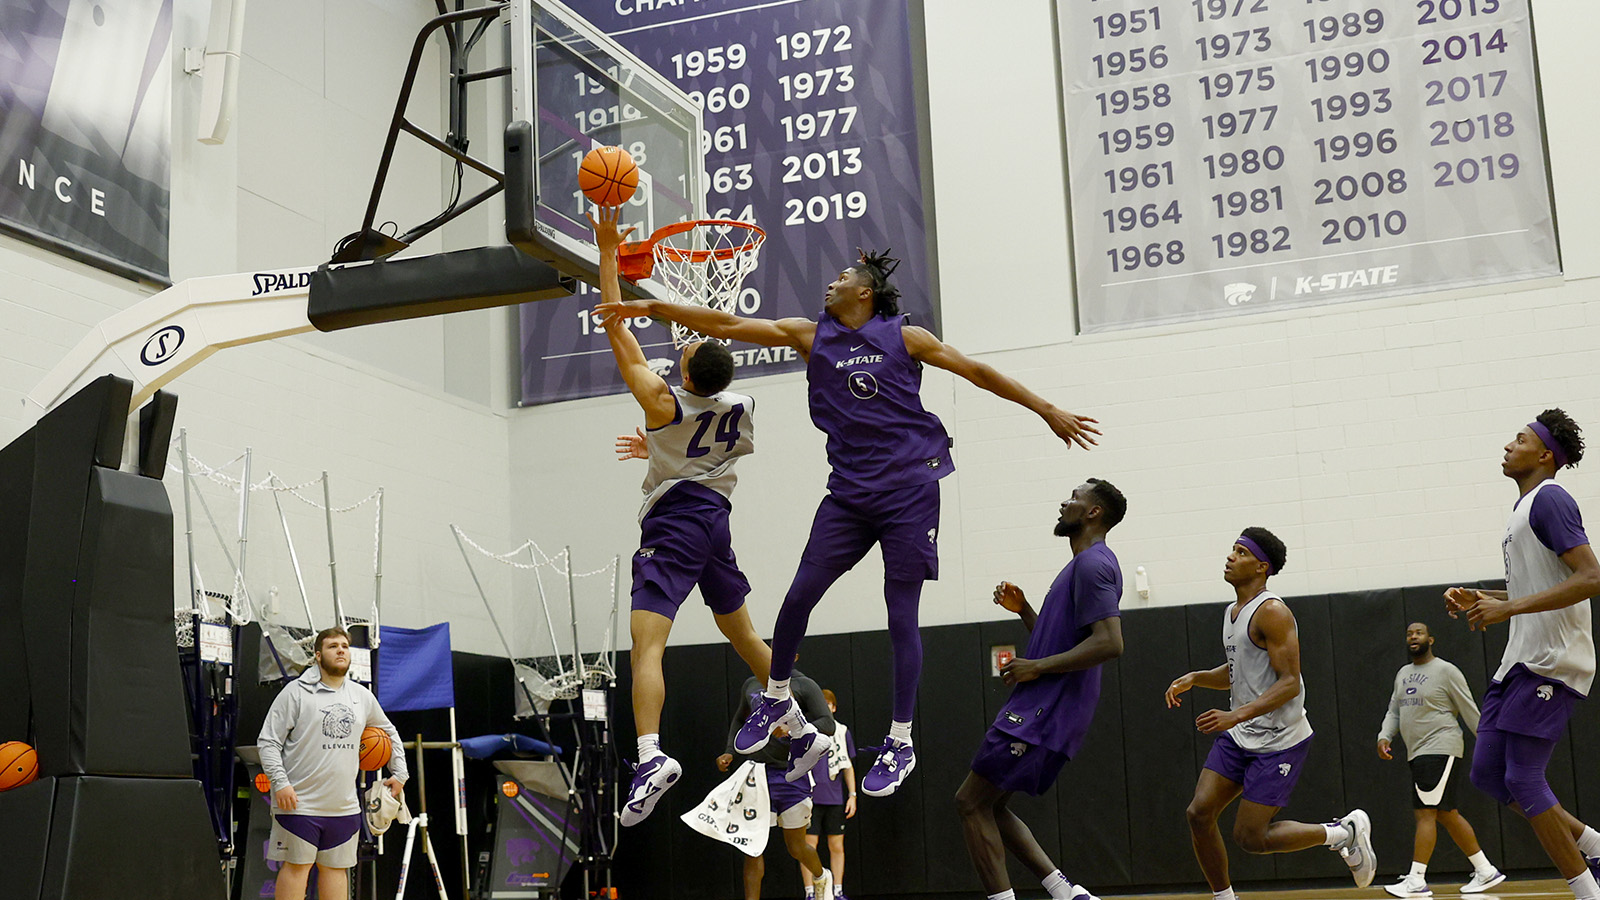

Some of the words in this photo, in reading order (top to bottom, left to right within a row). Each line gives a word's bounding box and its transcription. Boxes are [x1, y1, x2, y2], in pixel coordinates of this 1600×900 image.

[1092, 6, 1161, 39] 1951
[1192, 0, 1269, 22] 1972
[1303, 8, 1385, 44] 1989
[1416, 0, 1500, 25] 2013
[775, 25, 853, 61] 1972
[1195, 26, 1272, 61] 1973
[1421, 28, 1508, 65] 2014
[671, 43, 748, 79] 1959
[1092, 44, 1169, 78] 1956
[1305, 48, 1390, 83] 1990
[686, 83, 751, 114] 960
[778, 65, 856, 101] 1973
[1095, 83, 1172, 117] 1958
[1198, 66, 1275, 100] 1975
[1424, 70, 1508, 107] 2017
[1201, 105, 1279, 139] 1977
[1310, 87, 1393, 123] 1993
[702, 123, 748, 156] 961
[780, 106, 858, 142] 1977
[1097, 122, 1175, 155] 1959
[1429, 112, 1515, 147] 2018
[1203, 145, 1285, 179] 1980
[1313, 128, 1398, 163] 1996
[781, 147, 863, 184] 2013
[1104, 161, 1174, 194] 1961
[1433, 153, 1520, 188] 2019
[1211, 185, 1284, 218] 1981
[1313, 168, 1408, 205] 2008
[784, 190, 868, 227] 2019
[1102, 200, 1183, 233] 1964
[1211, 226, 1292, 258] 1982
[1321, 209, 1408, 245] 2010
[1106, 239, 1186, 273] 1968
[252, 271, 312, 297] SPALD
[1294, 264, 1400, 296] K-STATE
[730, 346, 798, 368] STATE
[835, 354, 884, 369] K-STATE
[855, 377, 868, 392] 5
[685, 401, 745, 459] 24
[743, 807, 757, 821] G
